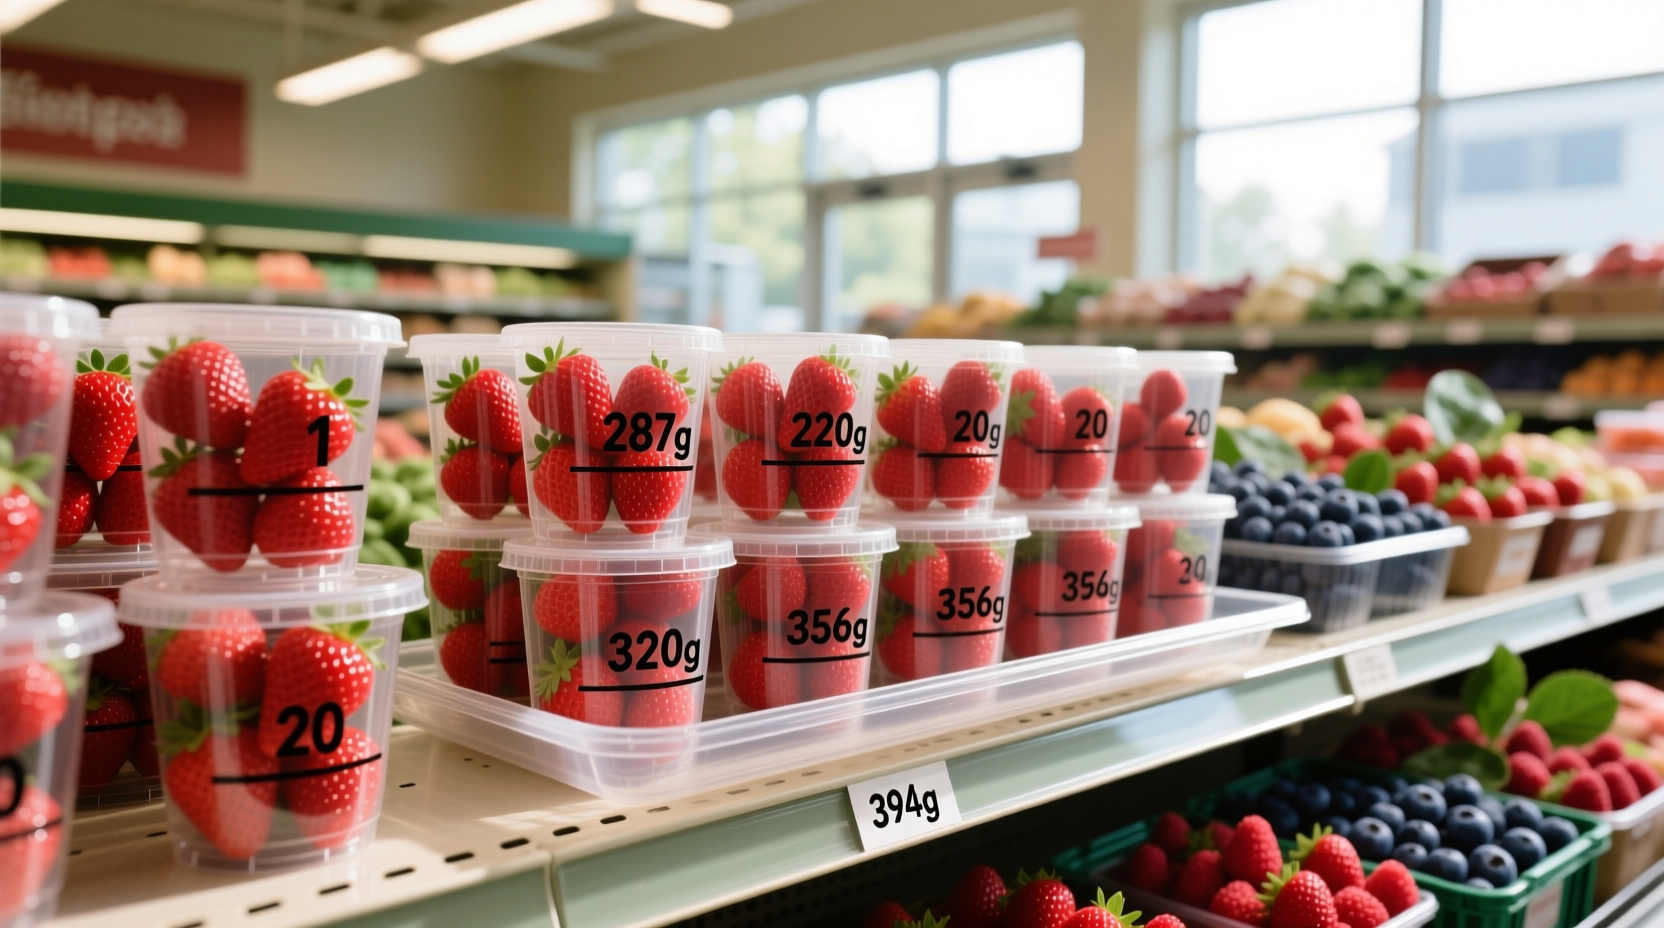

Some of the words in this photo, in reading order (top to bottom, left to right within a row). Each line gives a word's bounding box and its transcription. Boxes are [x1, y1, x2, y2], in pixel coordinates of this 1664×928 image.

[307, 415, 330, 467] 1
[603, 411, 691, 461] 287g
[789, 411, 867, 455] 220g
[952, 409, 1001, 450] 20g
[1075, 409, 1107, 440] 20
[1185, 409, 1210, 437] 20
[936, 585, 1005, 623] 356g
[1062, 570, 1119, 605] 356g
[787, 606, 868, 649] 356g
[607, 628, 701, 673] 320g
[276, 701, 344, 757] 20
[869, 783, 939, 828] 394g
